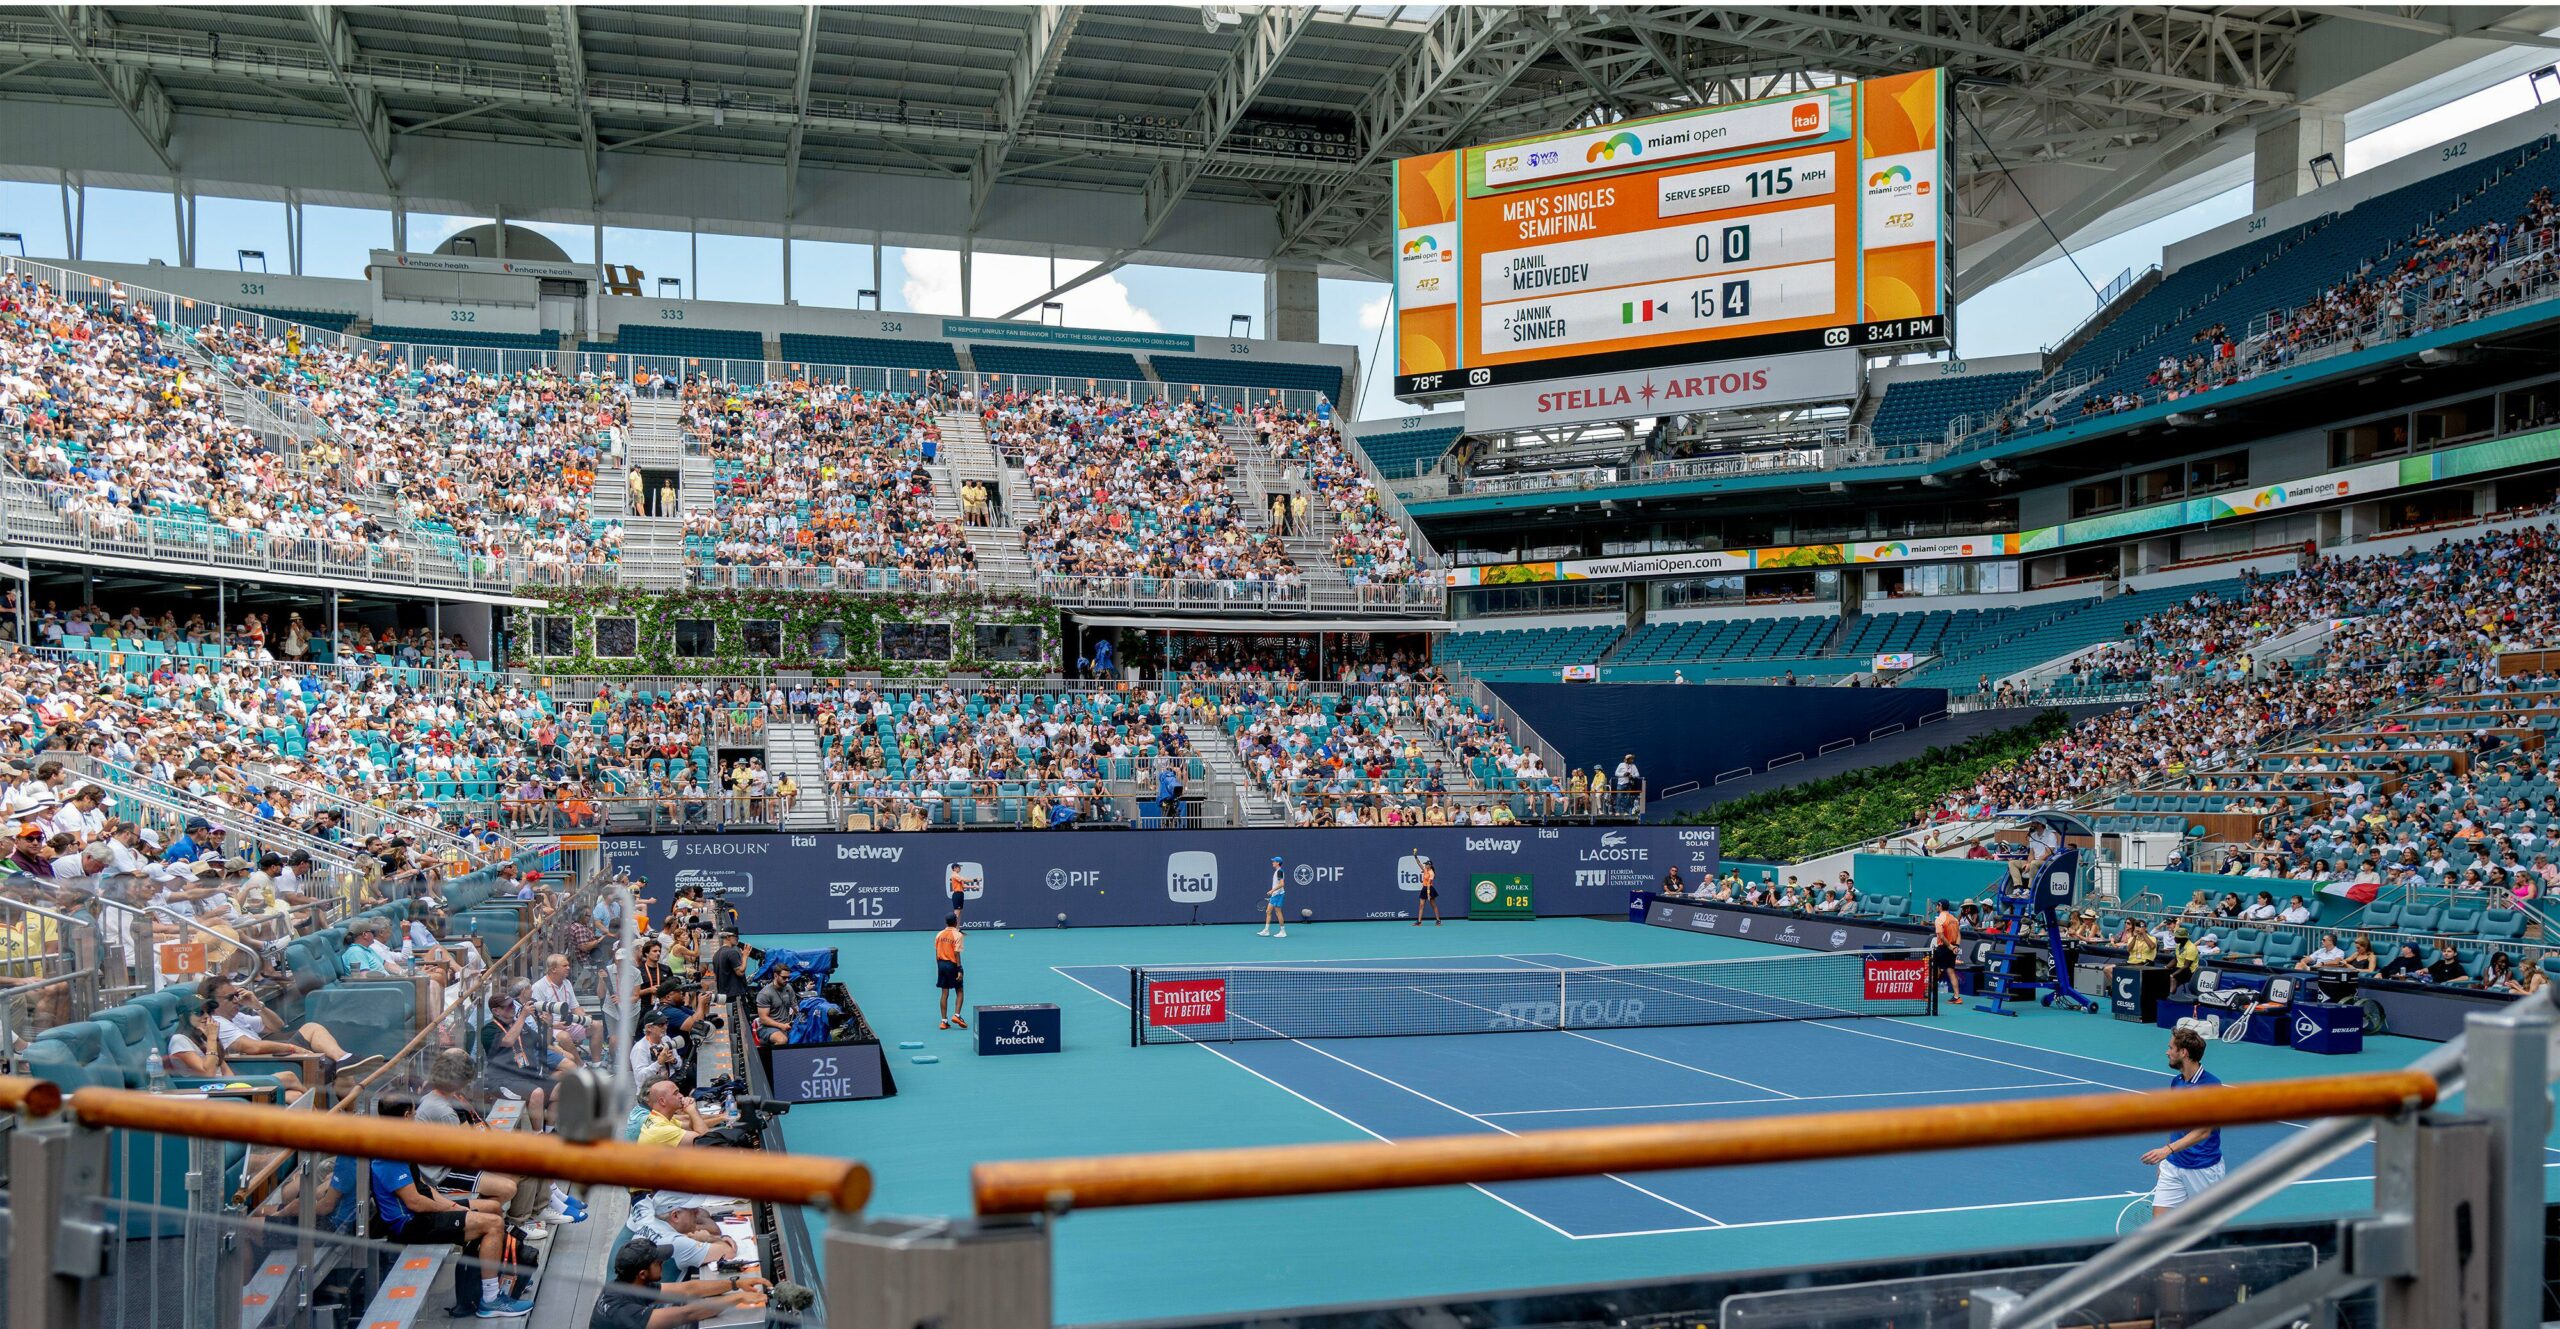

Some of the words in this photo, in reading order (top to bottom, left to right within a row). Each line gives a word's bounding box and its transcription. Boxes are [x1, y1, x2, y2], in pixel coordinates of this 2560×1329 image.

[1648, 130, 1690, 148] miami
[1693, 126, 1727, 144] open
[1540, 152, 1559, 160] WTA
[2442, 142, 2467, 162] 342
[1493, 157, 1519, 170] ATP
[1542, 158, 1559, 166] 1000
[1746, 166, 1793, 198] 115
[1801, 170, 1826, 182] MPH
[1665, 189, 1697, 202] SERVE
[1698, 184, 1730, 199] SPEED
[1869, 186, 1892, 195] miami
[1894, 184, 1912, 192] open
[1503, 197, 1550, 222] MEN'S
[1554, 187, 1616, 212] SINGLES
[1519, 211, 1597, 240] SEMIFINAL
[1886, 213, 1914, 225] ATP
[2248, 217, 2267, 234] 341
[1696, 234, 1709, 262] 0
[1728, 229, 1744, 260] 0
[1403, 253, 1422, 262] miami
[1422, 252, 1438, 260] open
[1513, 255, 1546, 271] DANIIL
[409, 260, 444, 269] enhance
[444, 262, 470, 270] health
[515, 267, 548, 275] enhance
[548, 268, 573, 276] health
[1504, 266, 1510, 278] 3
[1513, 264, 1589, 290] MEDVEDEV
[240, 283, 266, 296] 331
[1416, 278, 1440, 289] ATP
[1690, 289, 1714, 318] 15
[1728, 285, 1744, 315] 4
[451, 310, 475, 322] 332
[661, 309, 684, 320] 333
[1513, 306, 1552, 322] JANNIK
[881, 322, 902, 332] 334
[1504, 319, 1510, 330] 2
[1513, 320, 1566, 342] SINNER
[958, 326, 980, 334] REPORT
[1020, 330, 1049, 338] BEHAVIOR
[1112, 336, 1140, 344] LOCATION
[1828, 330, 1848, 344] CC
[1868, 322, 1903, 340] 3:41
[1910, 319, 1933, 336] PM
[1230, 344, 1250, 354] 336
[1941, 362, 1967, 376] 340
[1412, 375, 1443, 391] 78°F
[1471, 371, 1489, 384] CC
[1538, 385, 1632, 414] STELLA
[1664, 370, 1768, 400] ARTOIS
[1402, 417, 1422, 430] 337
[1693, 463, 1711, 476] BEST
[1500, 480, 1518, 492] BEST
[2289, 485, 2314, 498] miami
[2315, 482, 2334, 494] open
[1911, 544, 1937, 554] miami
[1938, 543, 1958, 554] open
[1588, 557, 1722, 575] www.MiamiOpen.com
[602, 840, 646, 850] DOBEL
[686, 843, 767, 856] SEABOURN
[1466, 836, 1522, 854] betway
[837, 844, 904, 863] betway
[1580, 849, 1648, 862] LACOSTE
[1692, 852, 1705, 862] 25
[618, 865, 632, 876] 25
[1316, 866, 1344, 882] PIF
[1070, 871, 1100, 887] PIF
[1575, 870, 1606, 887] FIU
[830, 884, 850, 894] SAP
[858, 886, 879, 894] SERVE
[846, 897, 884, 916] 115
[1506, 896, 1528, 908] 0:25
[872, 920, 892, 928] MPH
[1694, 912, 1717, 923] HOLOGIC
[1774, 934, 1800, 944] LACOSTE
[178, 952, 188, 970] G
[1868, 968, 1922, 982] Emirates
[1876, 982, 1887, 994] FLY
[1889, 982, 1914, 993] BETTER
[1154, 988, 1221, 1005] Emirates
[2116, 1000, 2134, 1008] CELSIUS
[1165, 1006, 1179, 1018] FLY
[1181, 1004, 1212, 1018] BETTER
[1489, 1001, 1559, 1028] ATP
[1564, 1000, 1646, 1024] TOUR
[996, 1035, 1044, 1045] Protective
[812, 1057, 838, 1078] 25
[801, 1078, 852, 1099] SERVE
